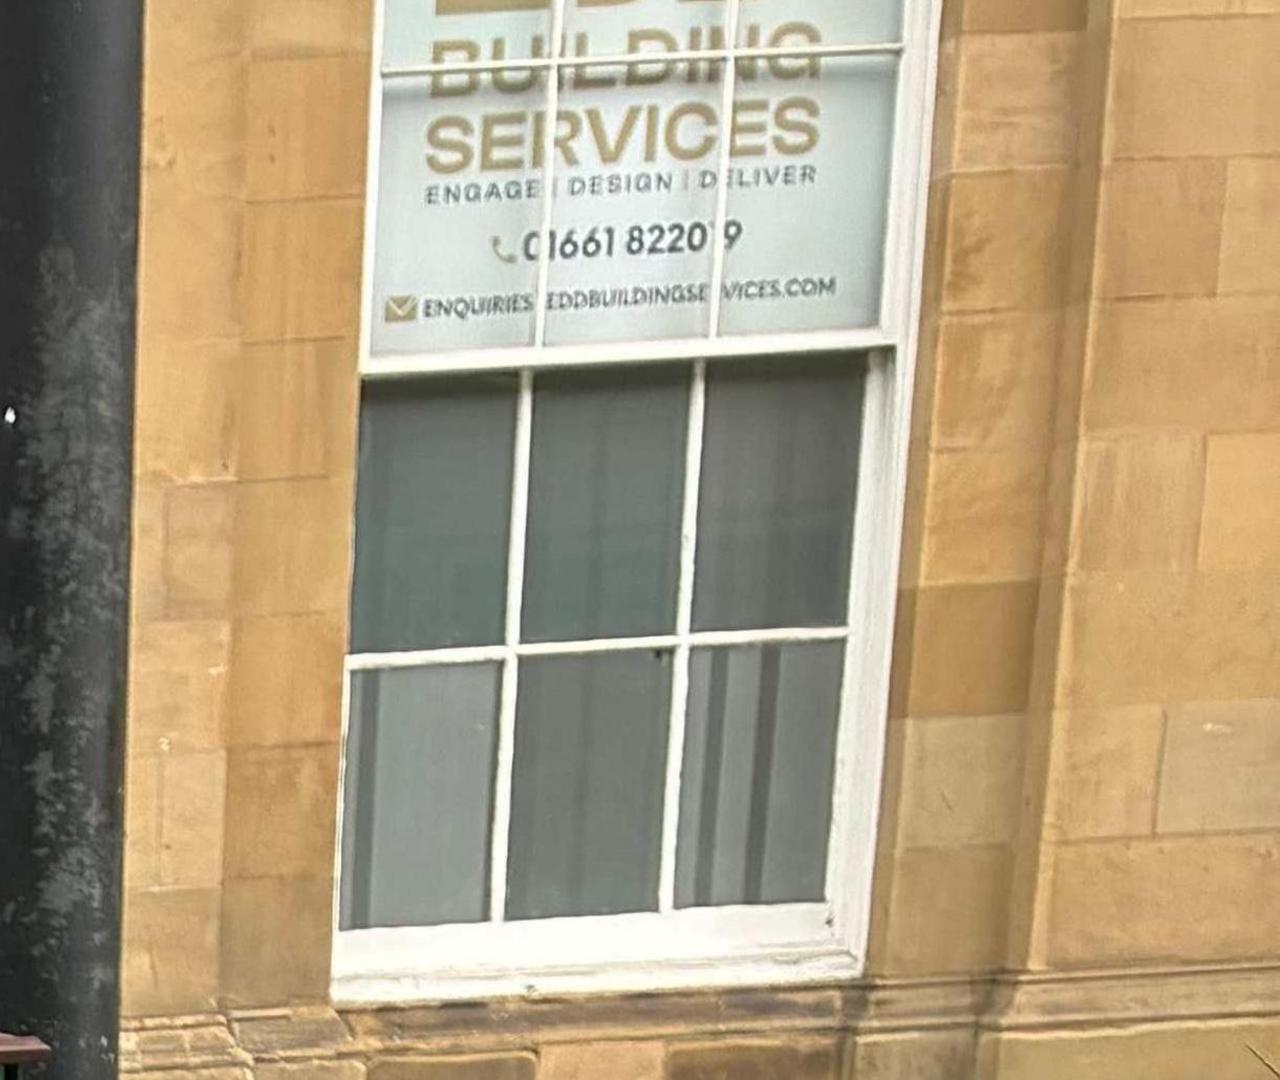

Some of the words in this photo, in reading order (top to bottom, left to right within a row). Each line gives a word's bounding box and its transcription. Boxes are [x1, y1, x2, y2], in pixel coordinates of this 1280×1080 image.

[423, 97, 820, 173] SERVICES
[424, 178, 540, 205] ENGAGE
[568, 171, 673, 197] DESIGN
[522, 226, 615, 262] 01661
[626, 219, 743, 256] 82209
[423, 276, 837, 321] ENQUIRIESEDDBUILDINGSEVICES.COM
